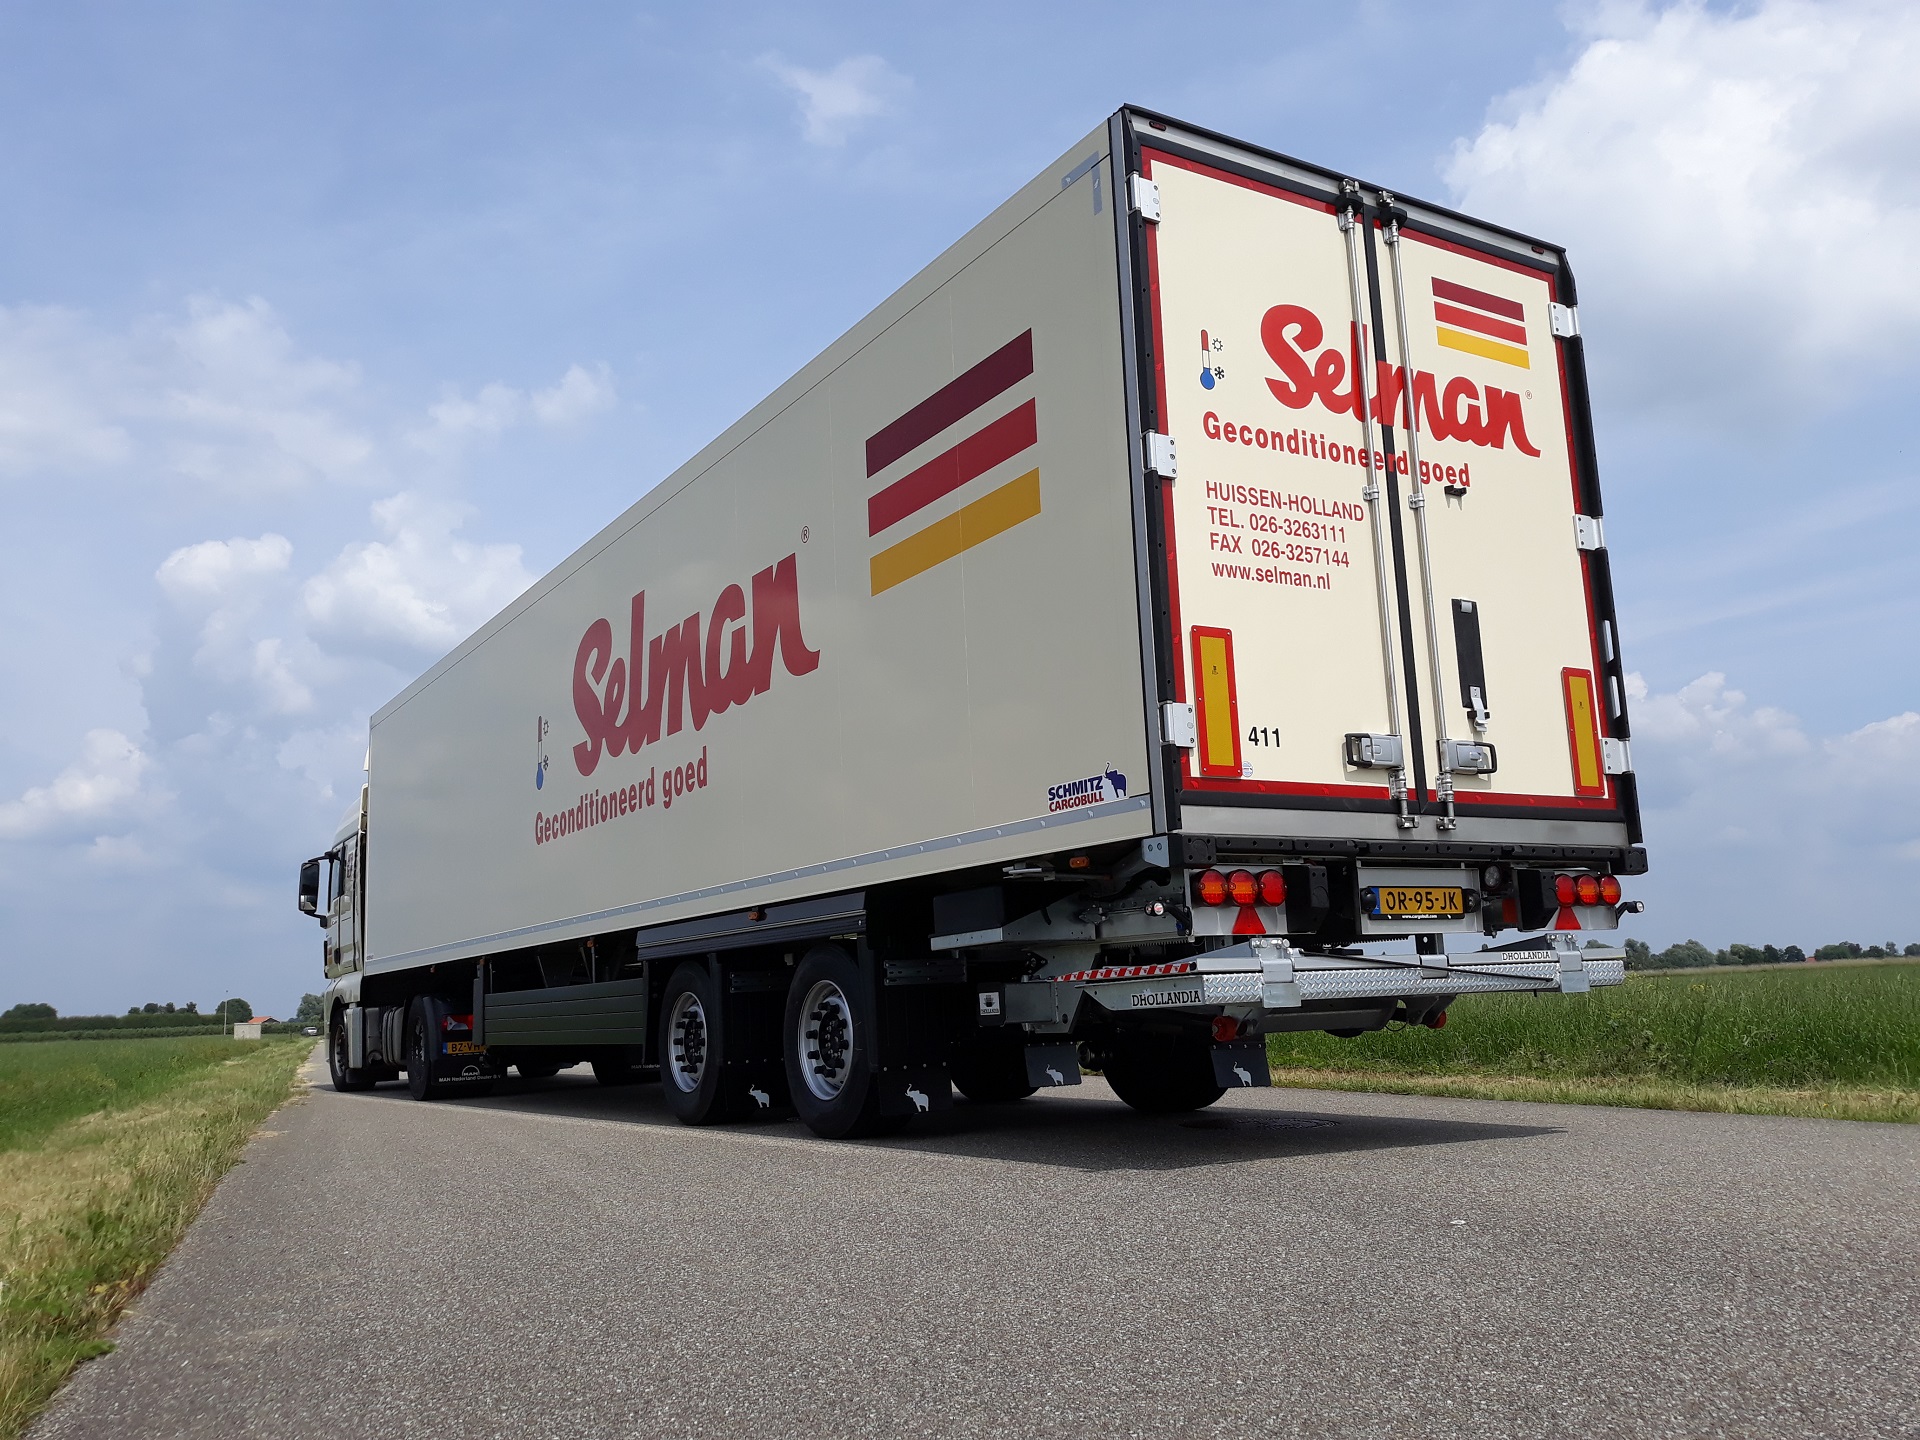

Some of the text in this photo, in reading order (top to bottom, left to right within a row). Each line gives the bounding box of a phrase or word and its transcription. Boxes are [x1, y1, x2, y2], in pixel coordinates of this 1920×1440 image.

[1260, 304, 1541, 458] Selman
[1202, 411, 1471, 487] Geconditioneerd goed
[1206, 480, 1364, 522] HUISSEN-HOLLAND
[1207, 506, 1346, 543] TEL. 026-3263111
[1210, 532, 1350, 568] FAX 026-3257144
[1211, 562, 1331, 590] www.selman.nl
[573, 552, 820, 777] Selman
[1248, 726, 1280, 748] 411
[535, 745, 708, 845] Geconditioneerd goed
[1048, 775, 1104, 802] SCHMITZ
[1049, 791, 1105, 813] CARGOBULL
[1386, 891, 1458, 910] OR-95-JK
[1501, 951, 1551, 961] DHOLLANDIA
[1131, 990, 1201, 1007] DHOLLANDIA
